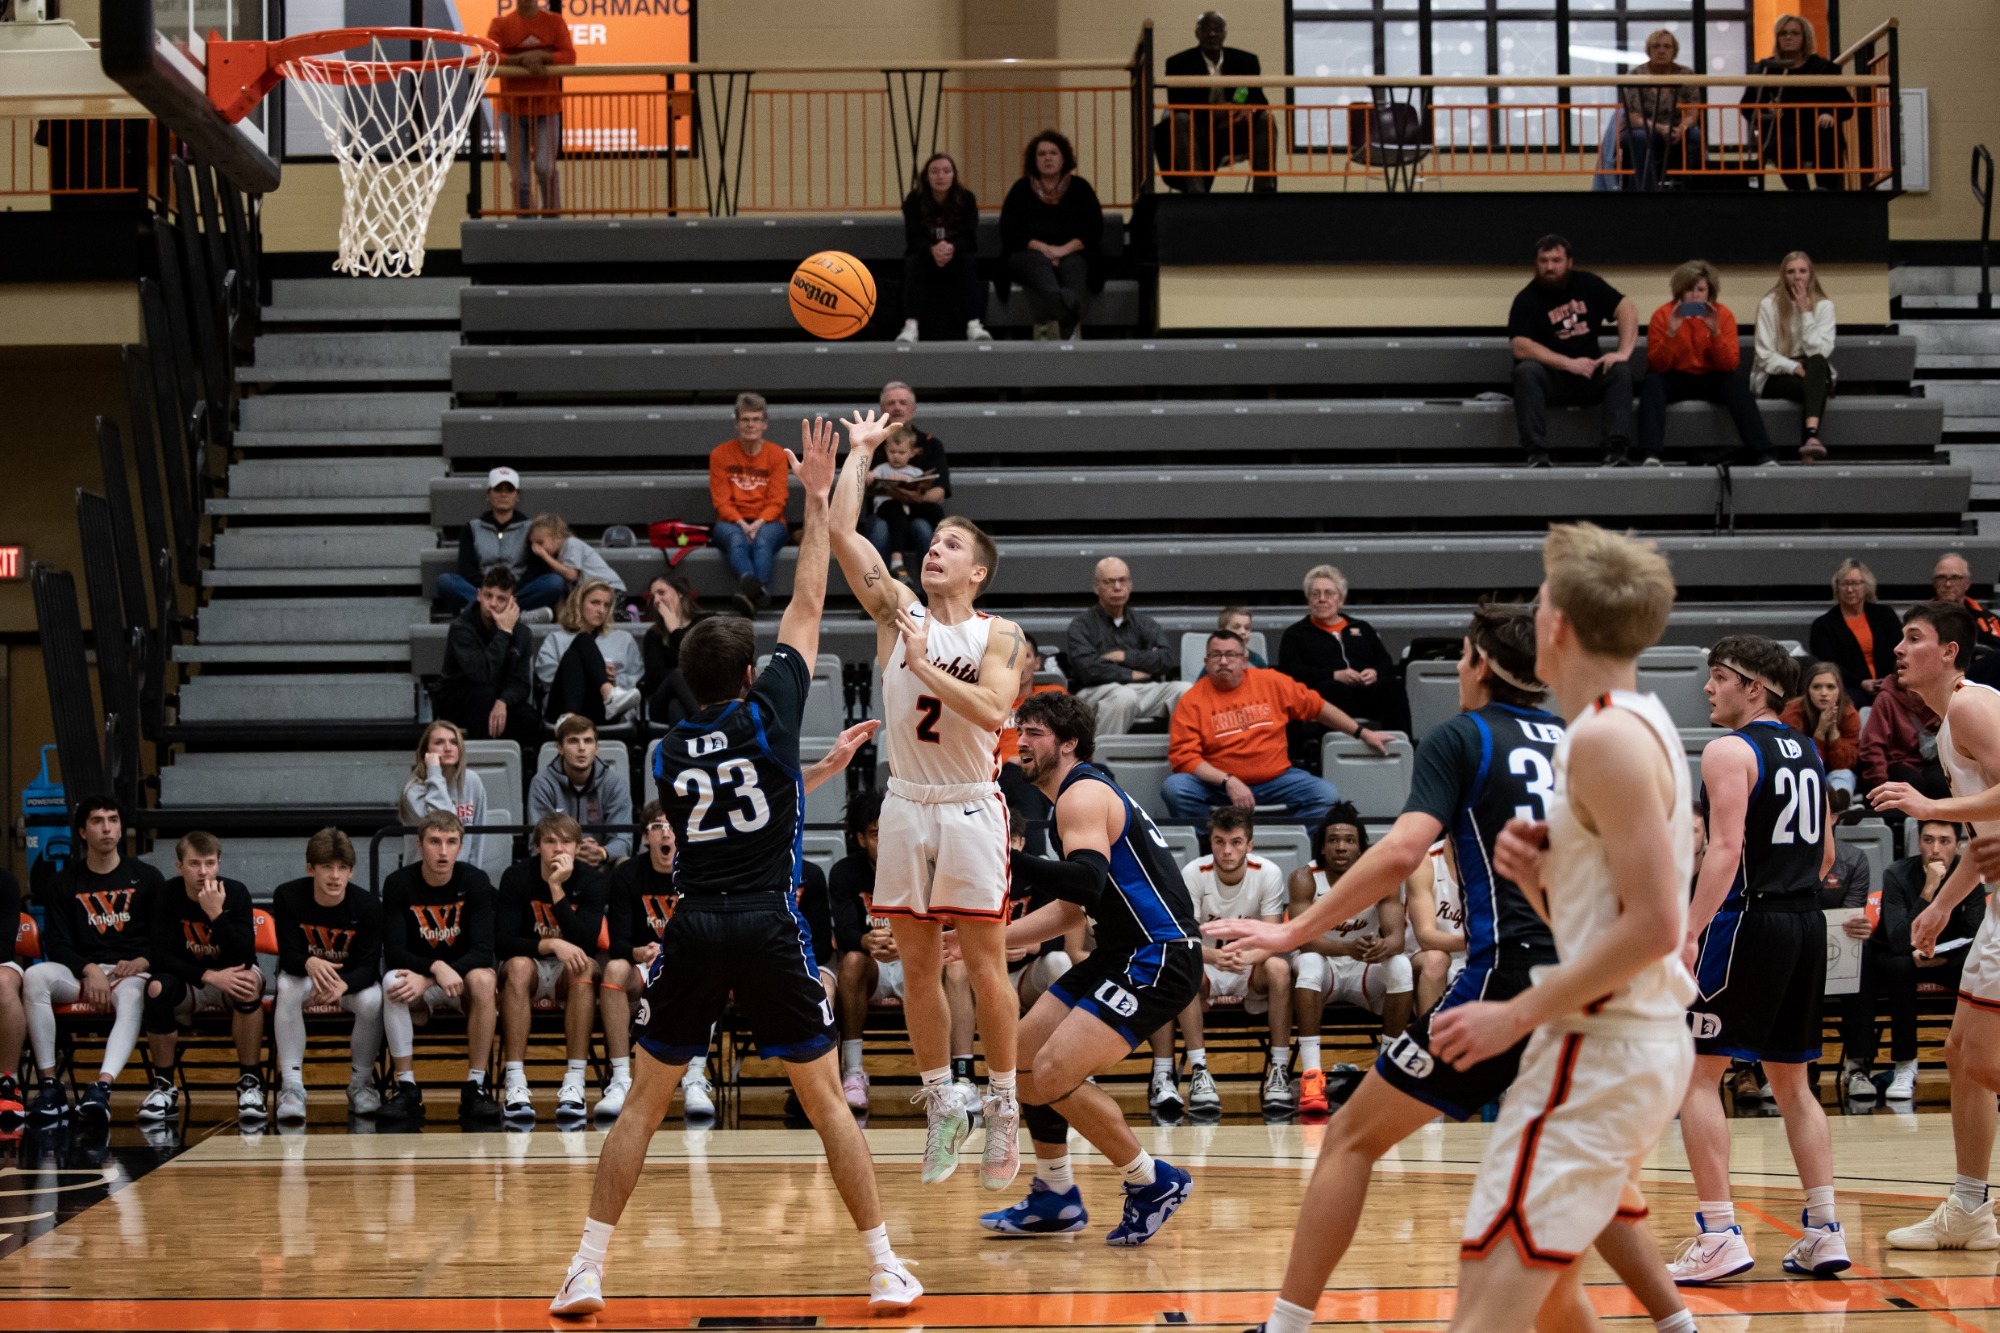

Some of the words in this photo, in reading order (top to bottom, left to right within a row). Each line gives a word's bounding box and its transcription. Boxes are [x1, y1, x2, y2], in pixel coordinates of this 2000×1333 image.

[793, 275, 840, 310] Wilson
[0, 547, 19, 577] IT
[915, 694, 943, 745] 2
[673, 758, 770, 843] 23
[1771, 767, 1820, 844] 20
[88, 910, 131, 927] Knights
